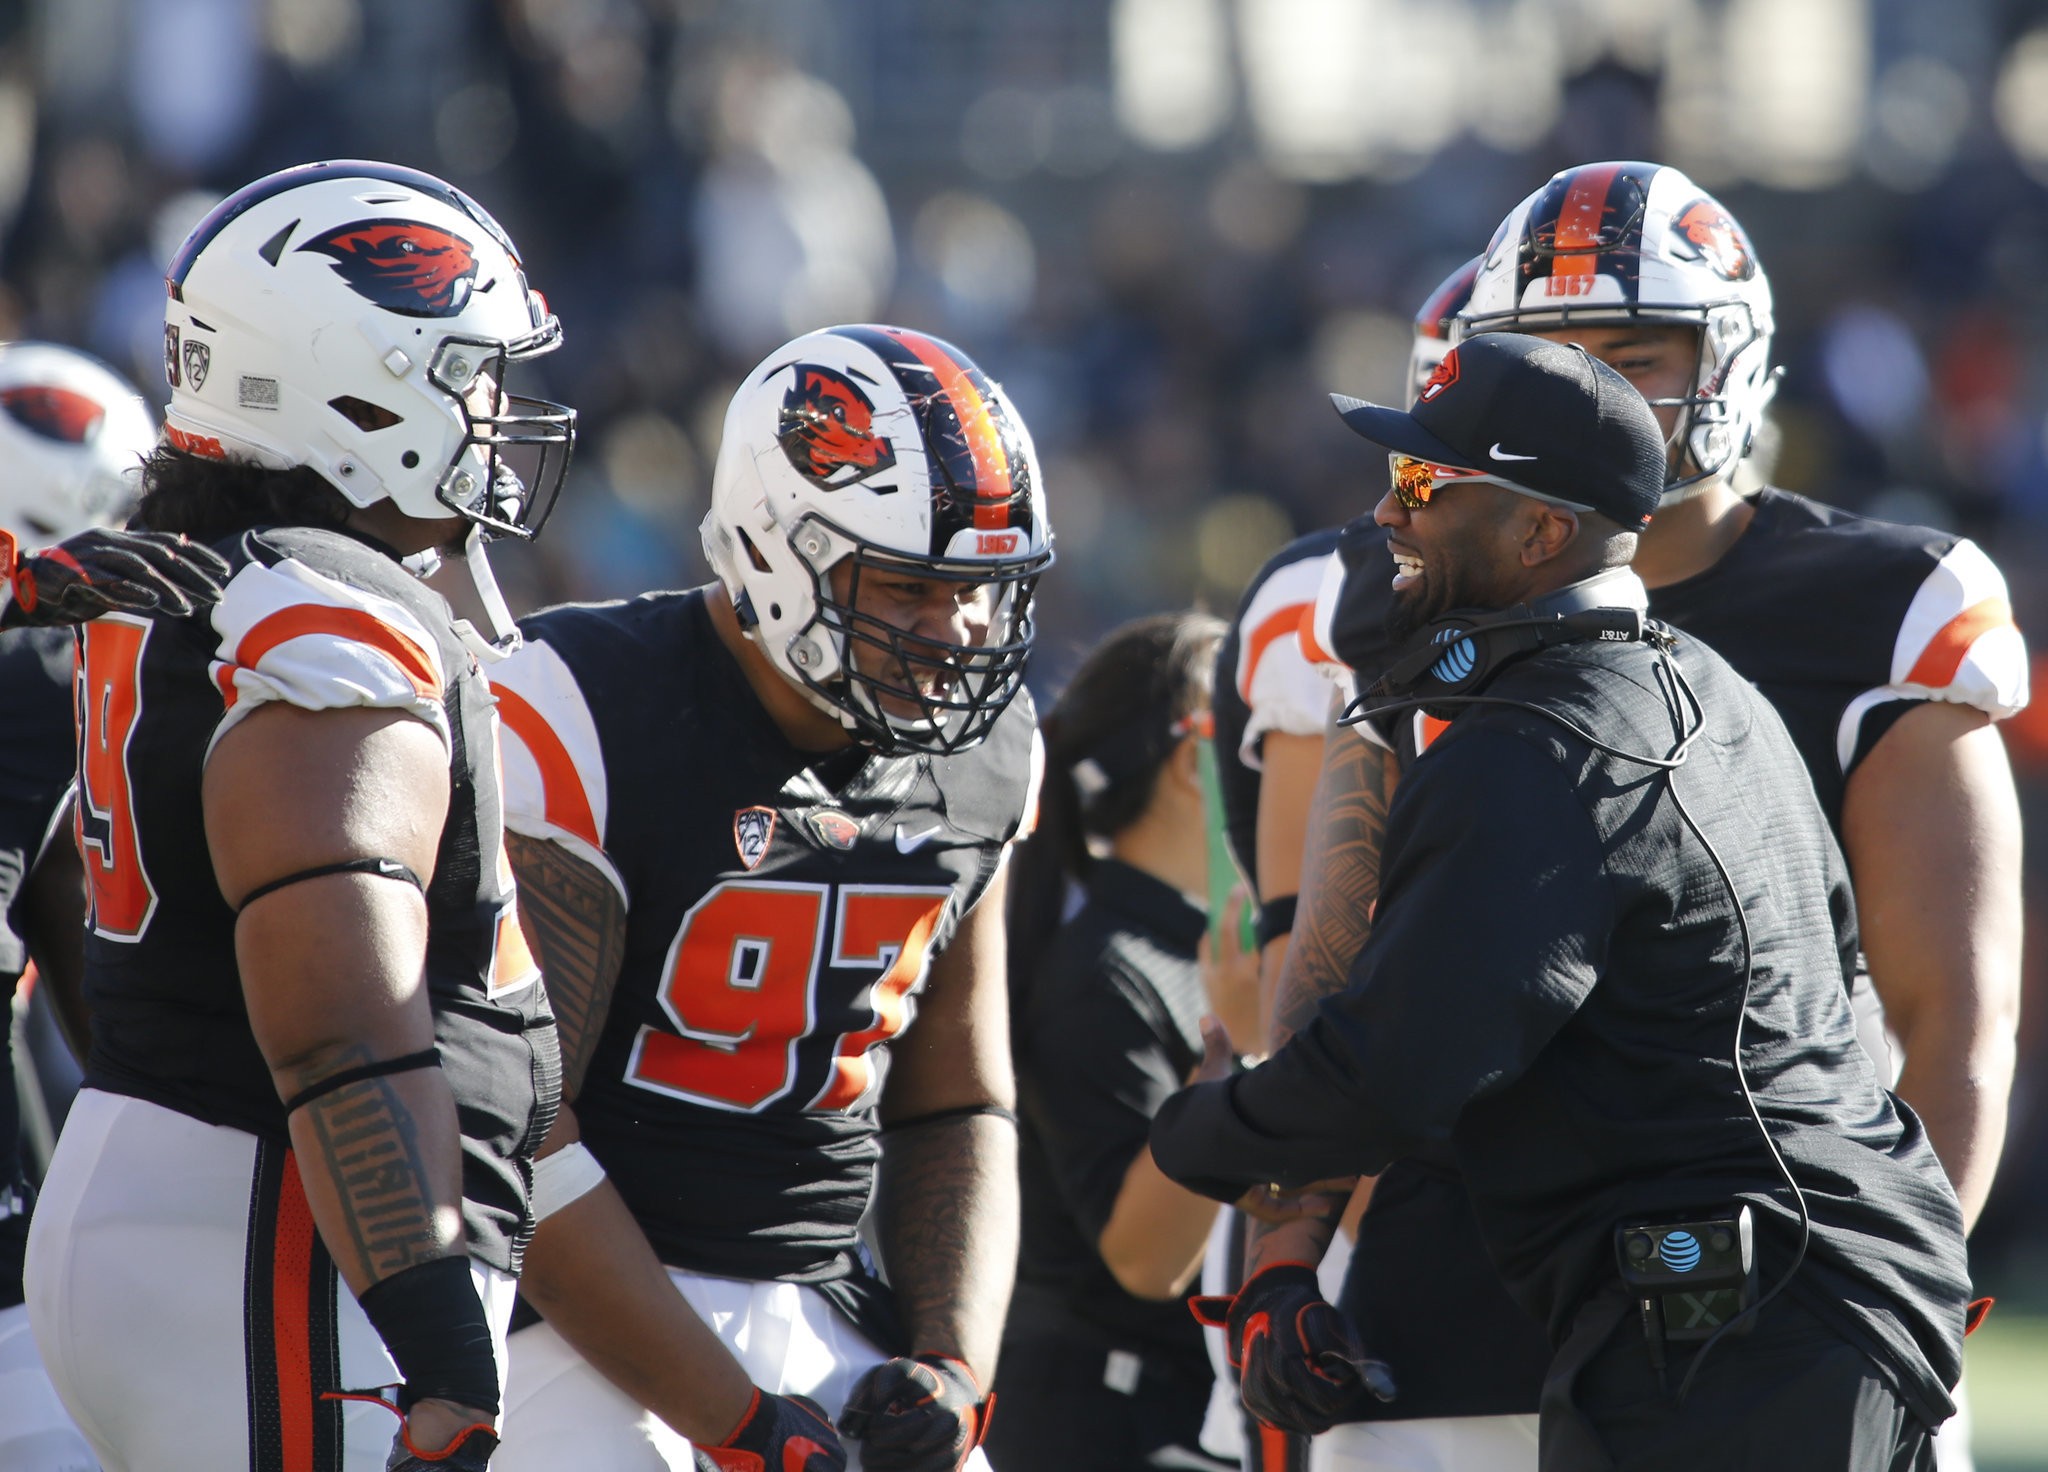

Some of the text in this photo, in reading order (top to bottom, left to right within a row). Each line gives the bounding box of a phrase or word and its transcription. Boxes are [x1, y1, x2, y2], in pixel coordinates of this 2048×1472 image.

[1544, 274, 1596, 297] 1967
[163, 320, 182, 388] 9
[976, 534, 1019, 555] 1967
[1598, 629, 1630, 641] AT&T
[622, 879, 956, 1115] 97
